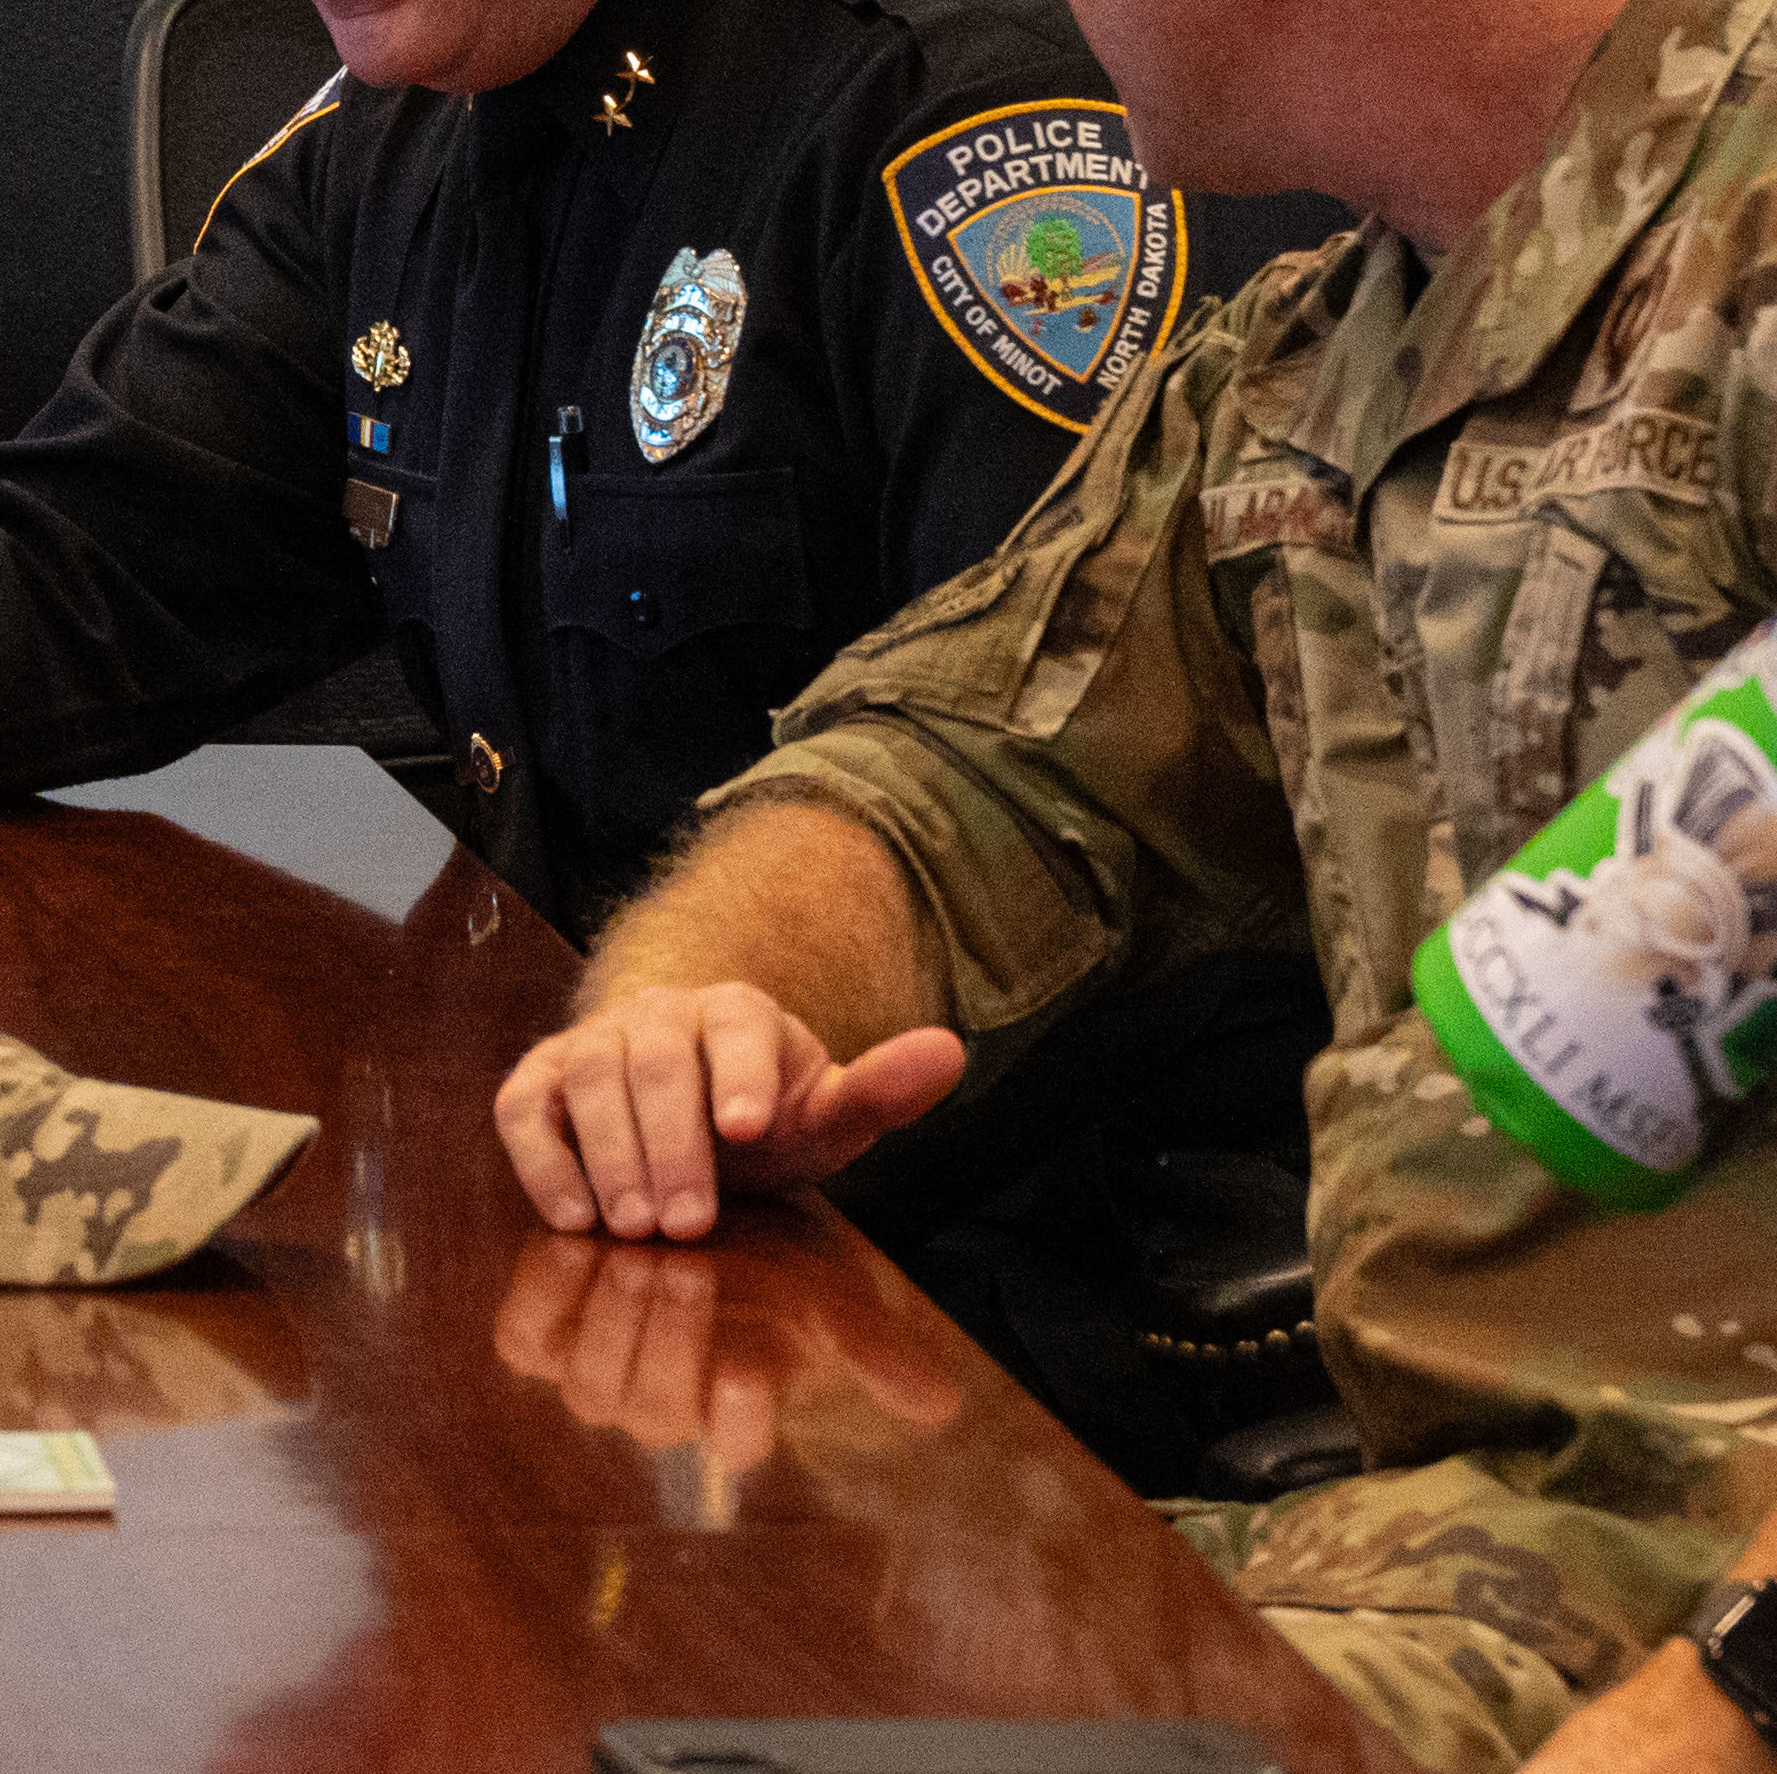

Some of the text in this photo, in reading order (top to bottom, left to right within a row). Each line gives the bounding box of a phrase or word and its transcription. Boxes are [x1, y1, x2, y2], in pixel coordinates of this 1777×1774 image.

[916, 151, 1148, 239] DEPARTMENT
[946, 119, 1103, 177] POLICE
[932, 255, 1063, 396] CITY OF MINOT
[1096, 202, 1169, 390] NORTH DAKOTA
